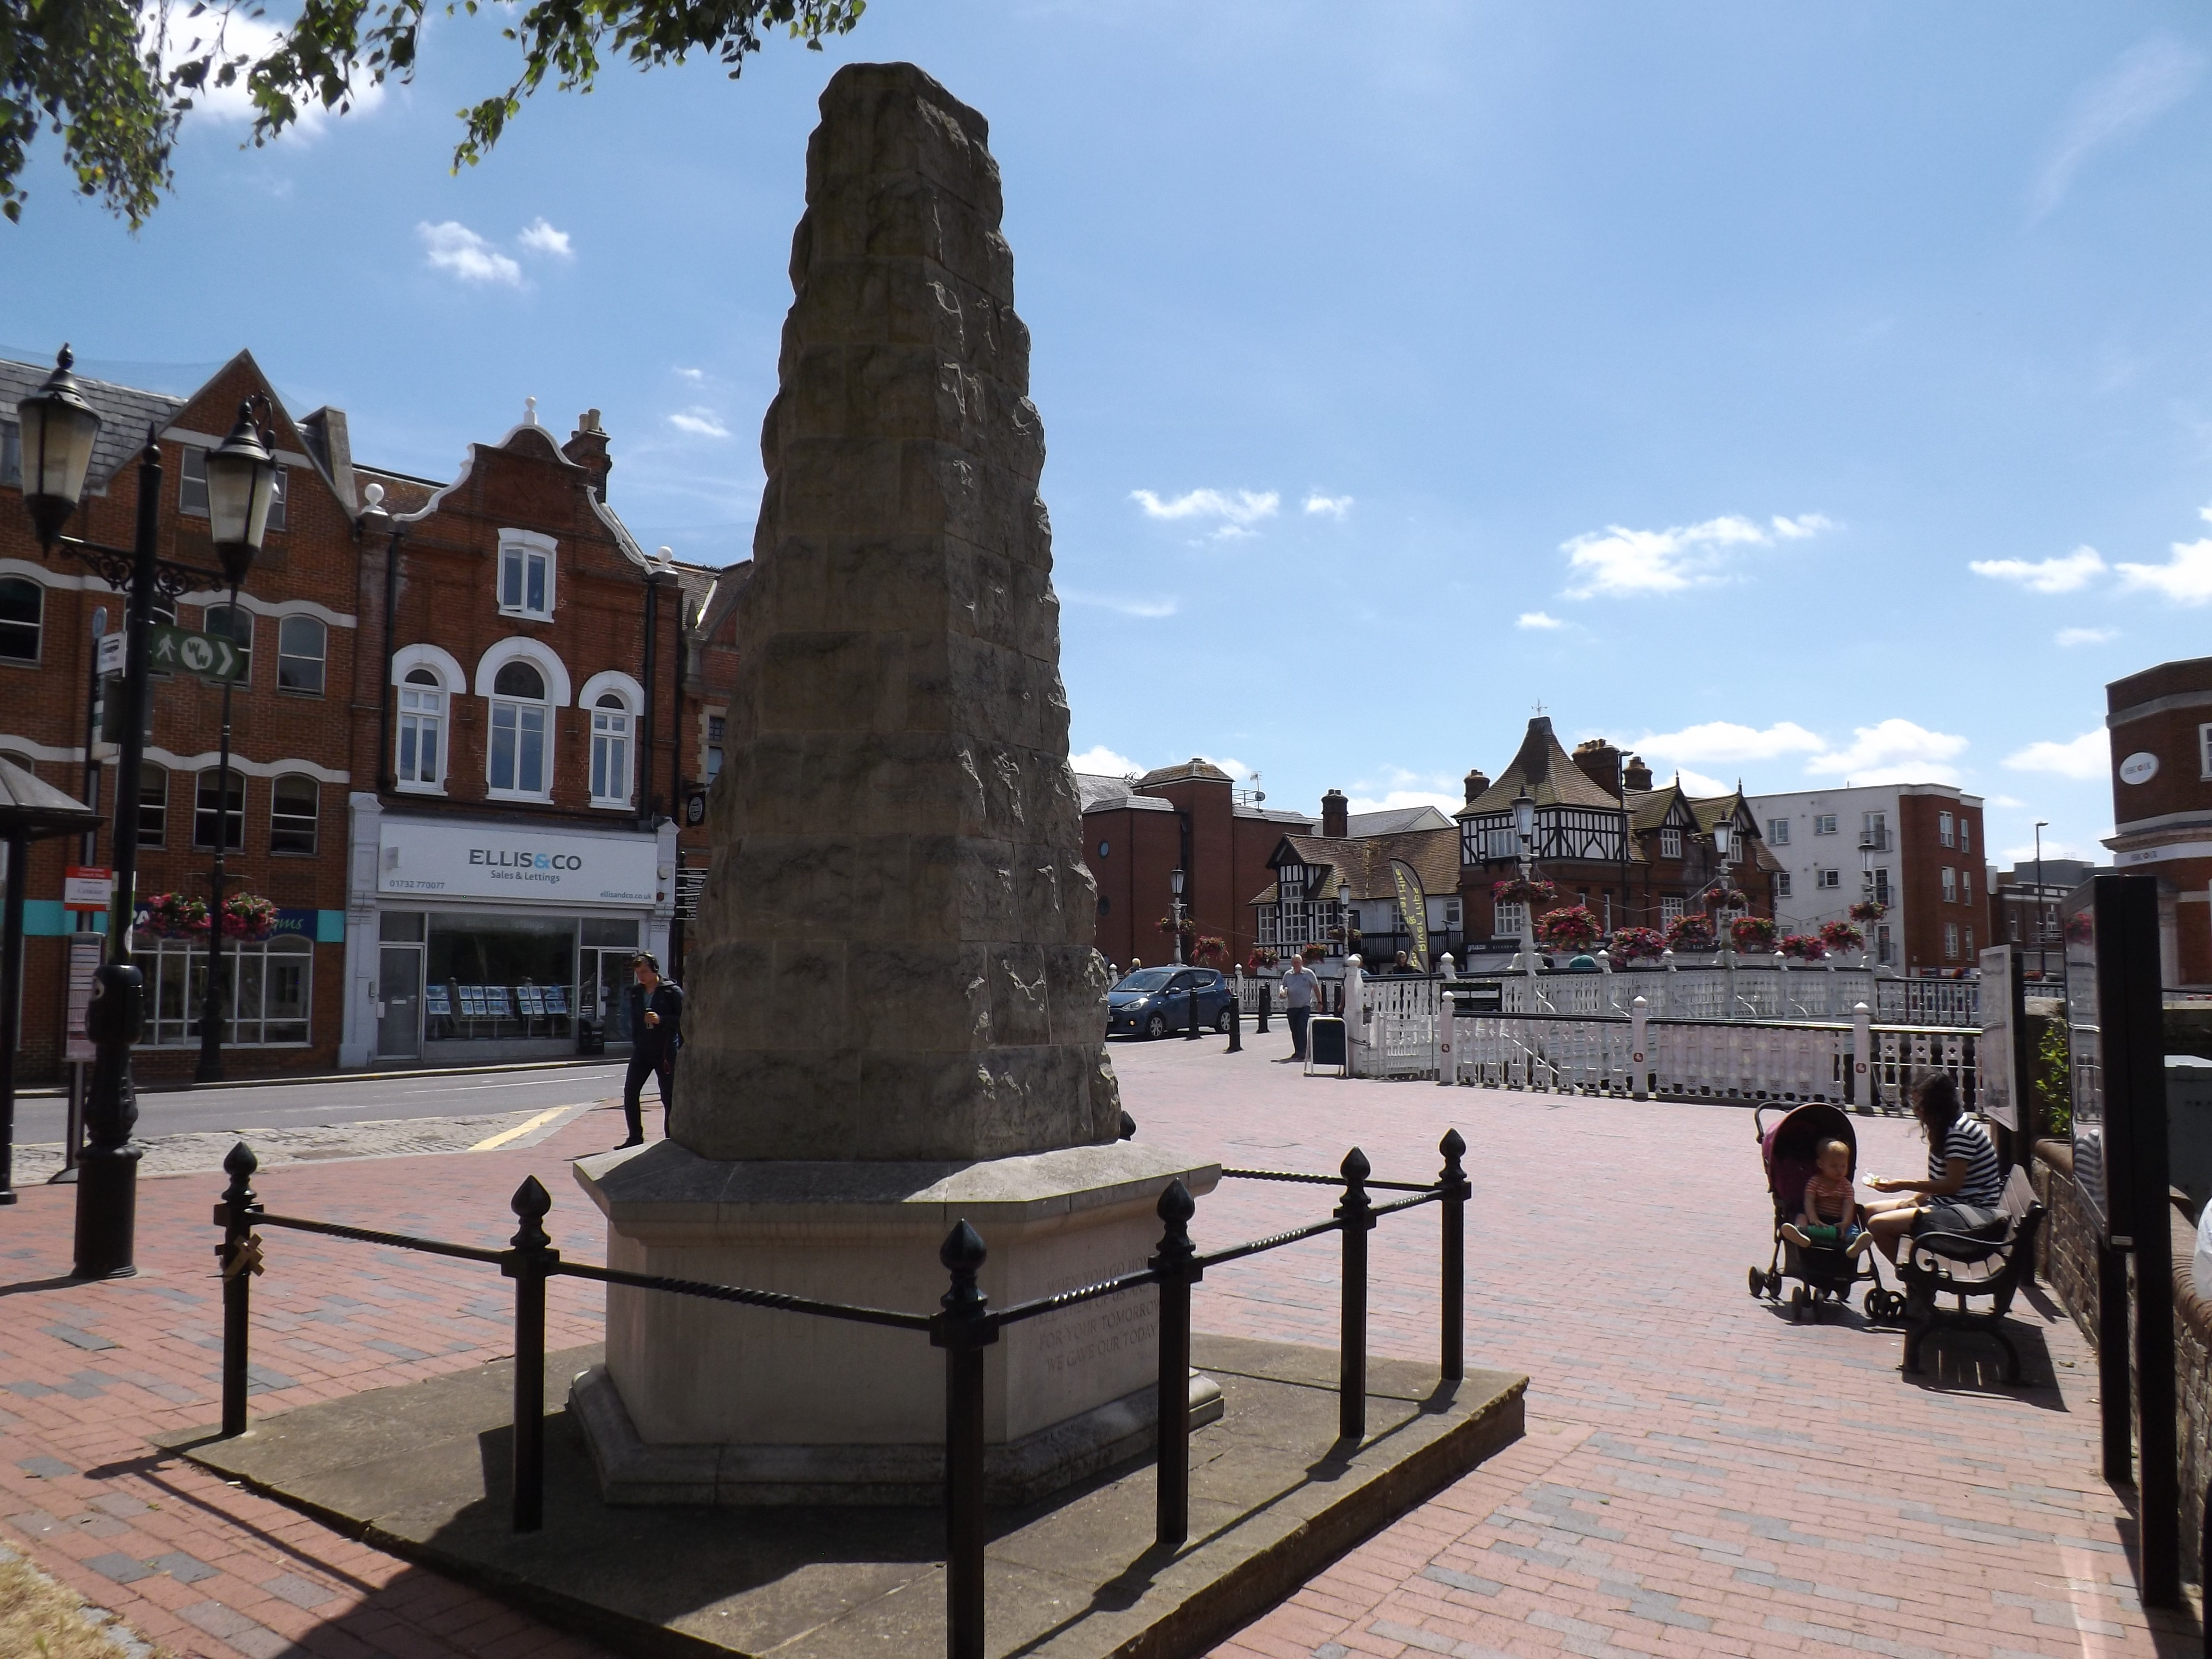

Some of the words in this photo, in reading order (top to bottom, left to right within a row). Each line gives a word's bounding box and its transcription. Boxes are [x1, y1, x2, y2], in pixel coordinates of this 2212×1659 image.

[469, 849, 582, 871] ELLIS&CO
[491, 870, 513, 879] Sales
[525, 872, 560, 884] Lettings
[390, 880, 414, 888] 01732
[416, 881, 445, 889] 770077
[600, 890, 652, 899] ellisandco.co.uk
[1047, 1354, 1063, 1372] WE
[1066, 1343, 1095, 1367] GAVE
[1097, 1336, 1120, 1355] OUR
[1123, 1324, 1156, 1346] TODAY
